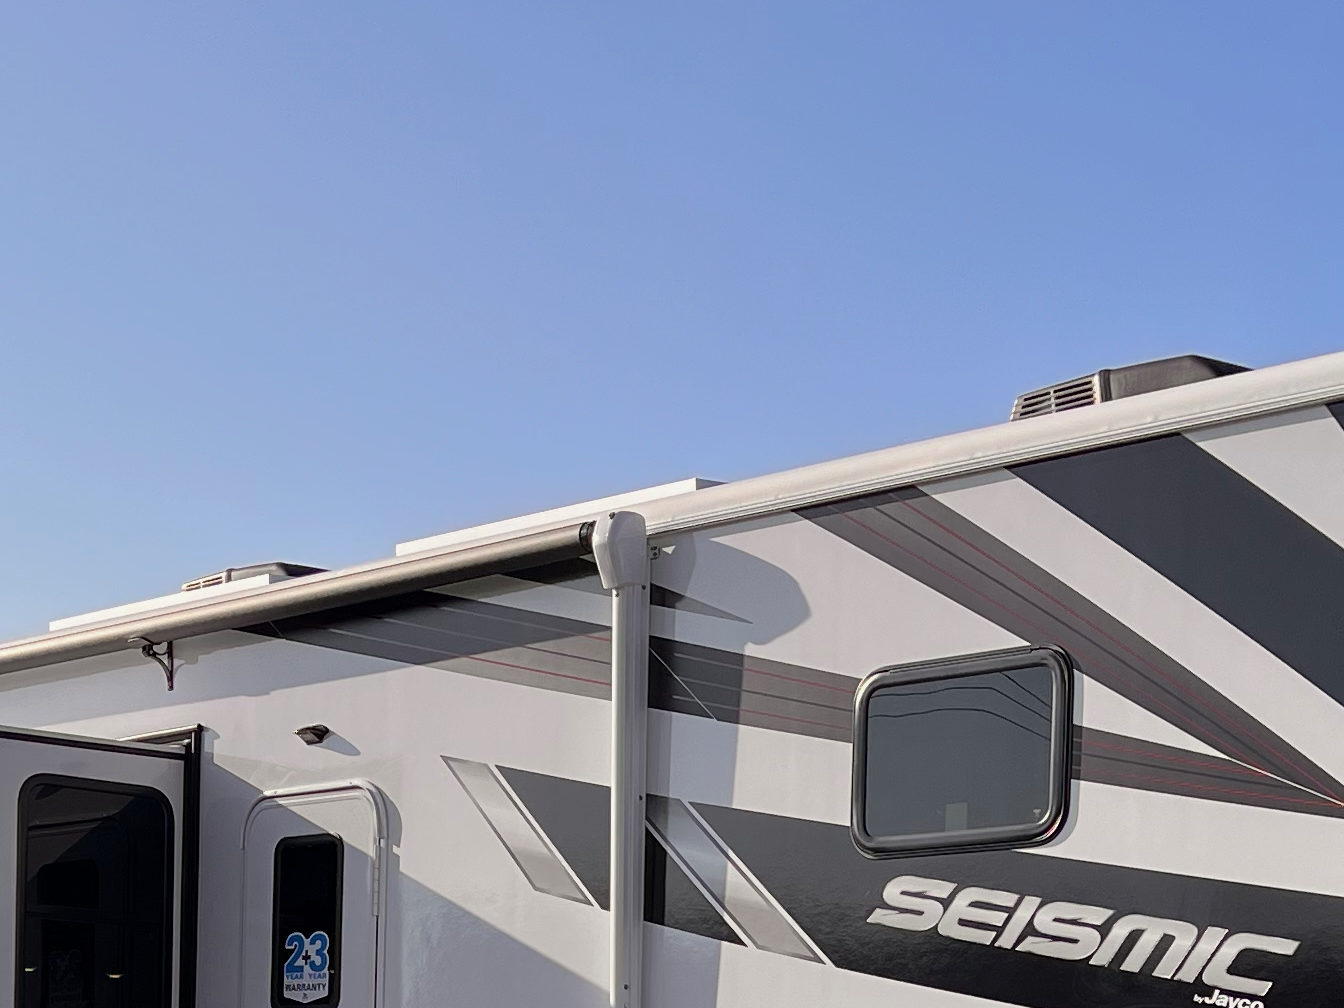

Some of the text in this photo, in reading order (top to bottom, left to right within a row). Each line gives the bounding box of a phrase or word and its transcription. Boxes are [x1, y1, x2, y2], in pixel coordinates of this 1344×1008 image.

[866, 874, 1301, 997] SEISMIC
[285, 983, 327, 991] WARRANTY
[1193, 993, 1205, 1004] by
